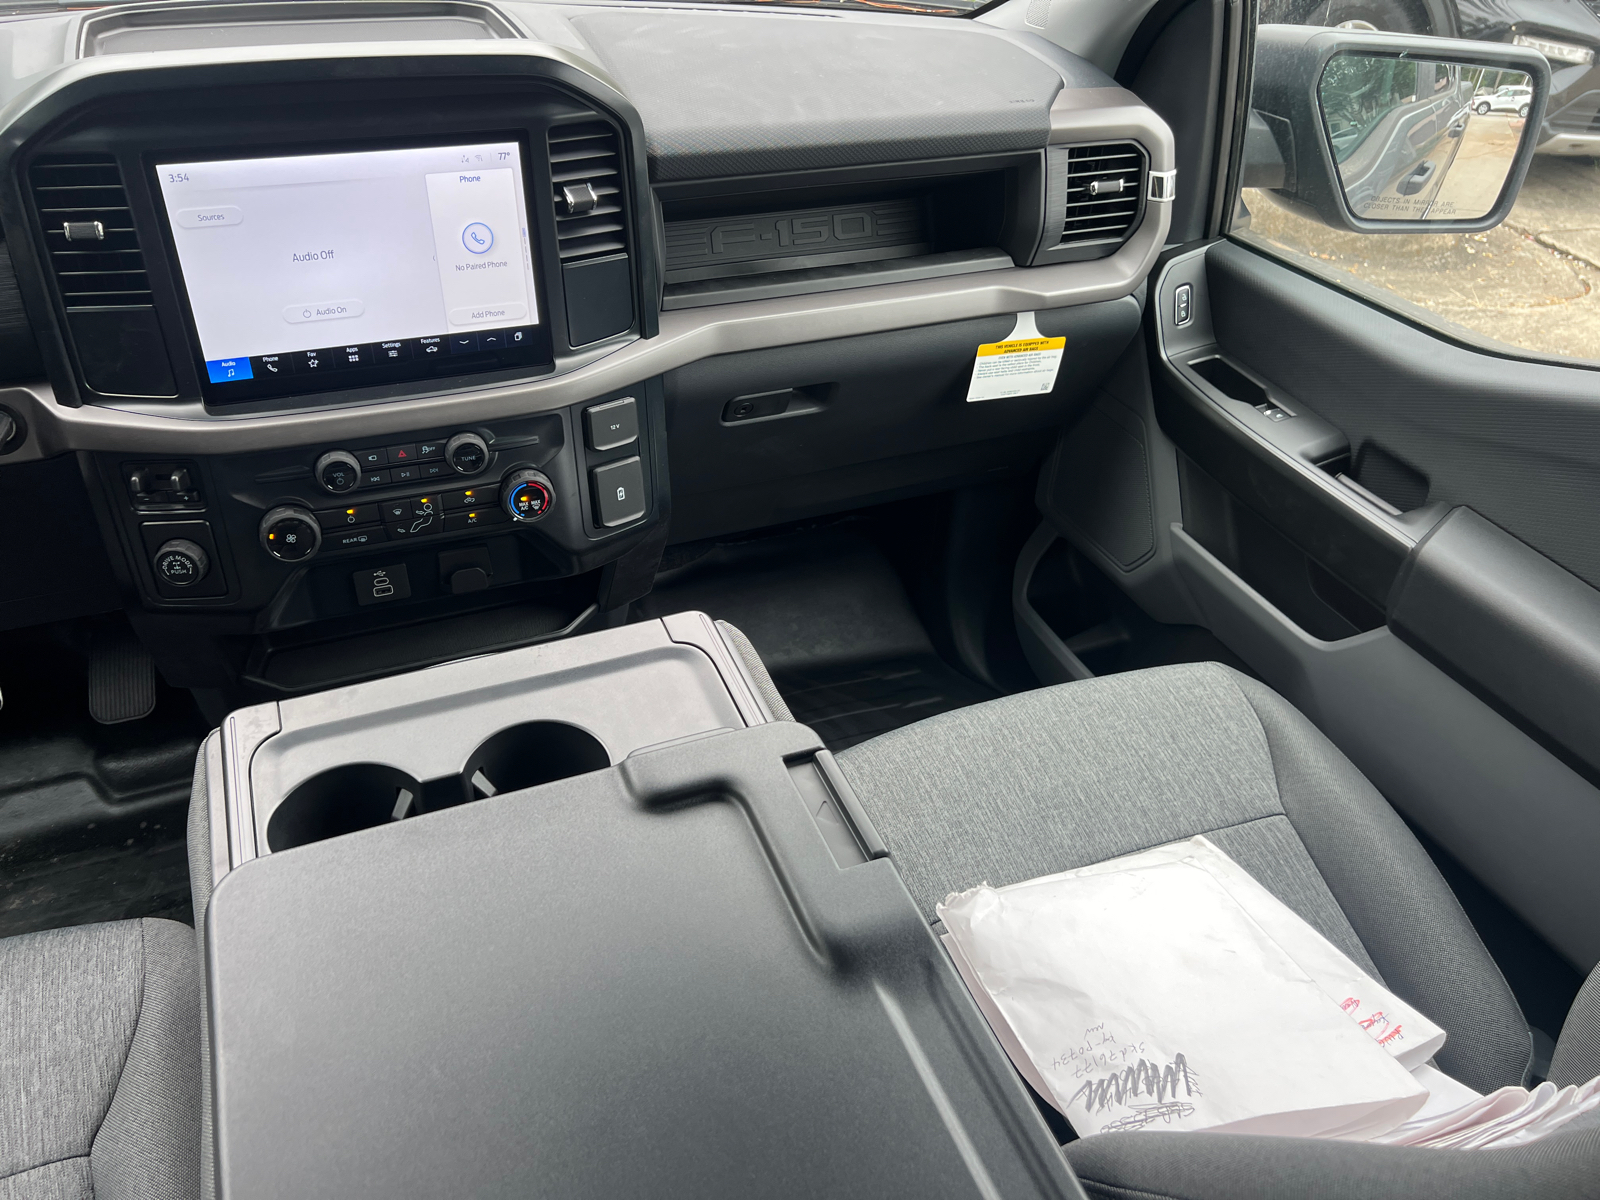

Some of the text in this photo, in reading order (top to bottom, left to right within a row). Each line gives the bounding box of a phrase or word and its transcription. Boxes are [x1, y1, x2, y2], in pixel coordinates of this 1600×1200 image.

[168, 174, 190, 183] 3:54
[459, 175, 481, 183] Phone
[197, 213, 225, 222] Sources
[710, 210, 876, 255] F-150
[292, 250, 334, 262] Audio Off
[466, 262, 486, 270] Paired
[487, 260, 508, 269] Phone
[316, 307, 336, 316] Audio
[472, 309, 505, 319] Add Phone
[382, 341, 401, 349] Settings
[162, 555, 193, 570] DRIVE MODE
